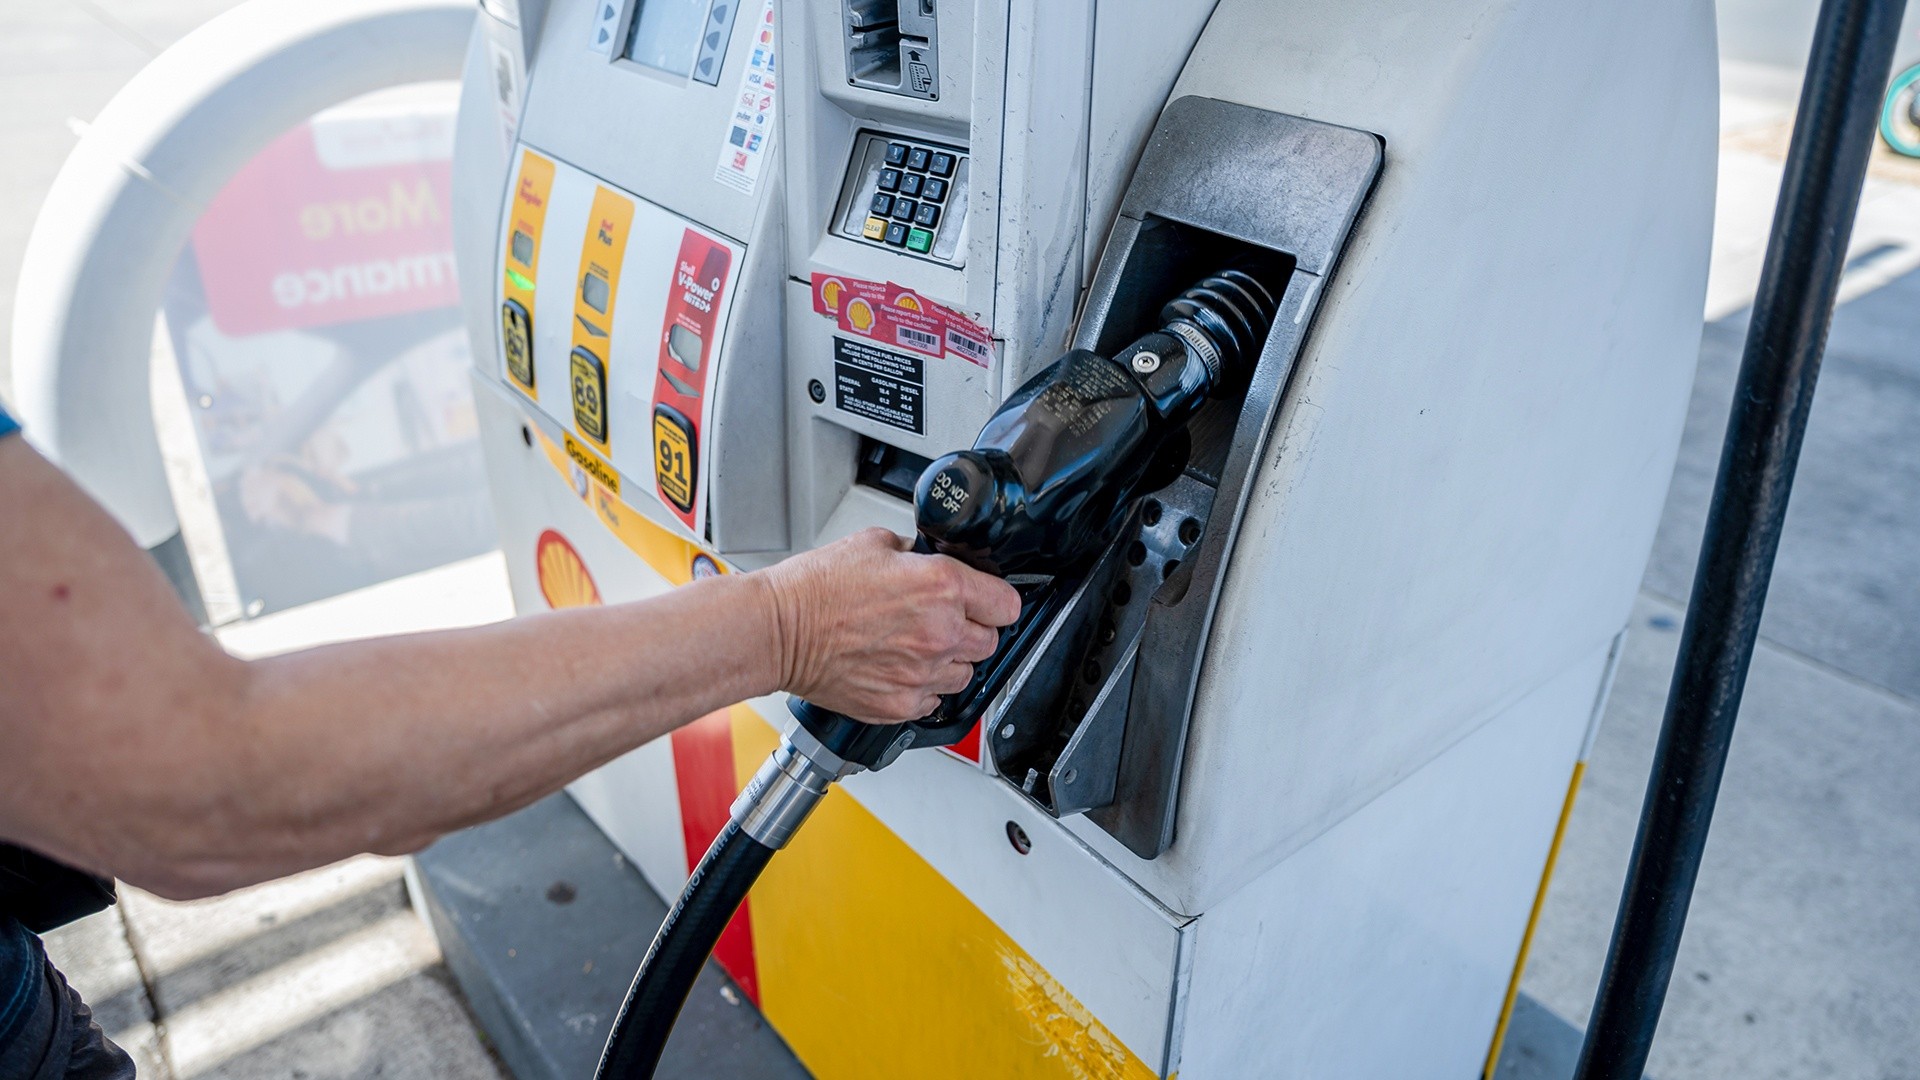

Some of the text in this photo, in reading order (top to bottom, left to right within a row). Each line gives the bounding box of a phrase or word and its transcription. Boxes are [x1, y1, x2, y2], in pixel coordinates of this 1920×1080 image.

[894, 148, 898, 156] 1
[915, 152, 921, 160] 2
[598, 228, 612, 246] Plus
[865, 224, 880, 232] CLEAR
[892, 227, 898, 235] 0
[909, 235, 925, 244] ENTER
[680, 261, 696, 276] Shell
[678, 271, 714, 302] V-Power
[881, 304, 896, 312] Please
[896, 310, 911, 318] report
[921, 315, 938, 324] broken
[932, 305, 947, 316] Please
[948, 313, 964, 323] report
[914, 322, 932, 330] cashier.
[956, 324, 965, 332] the
[841, 348, 860, 358] INCLUDE
[871, 356, 898, 368] FOLLOWING
[900, 364, 915, 373] TAXES
[845, 343, 860, 351] MOTOR
[862, 347, 880, 357] VEHICLE
[894, 356, 911, 365] PRICES
[859, 359, 872, 368] CENTS
[884, 366, 903, 376] GALLON
[838, 376, 861, 387] FEDERAL
[879, 387, 889, 396] 18.4
[839, 384, 854, 394] STATE
[871, 377, 919, 396] GASOLINE DIESEL
[575, 376, 598, 415] 89
[876, 405, 900, 416] APPLICABLE
[566, 440, 618, 493] Gasoline
[660, 440, 687, 486] 91
[936, 472, 969, 503] DO NOT
[942, 496, 961, 514] OFF
[711, 833, 728, 860] HW
[684, 867, 705, 901] LOW
[662, 899, 684, 936] PERM
